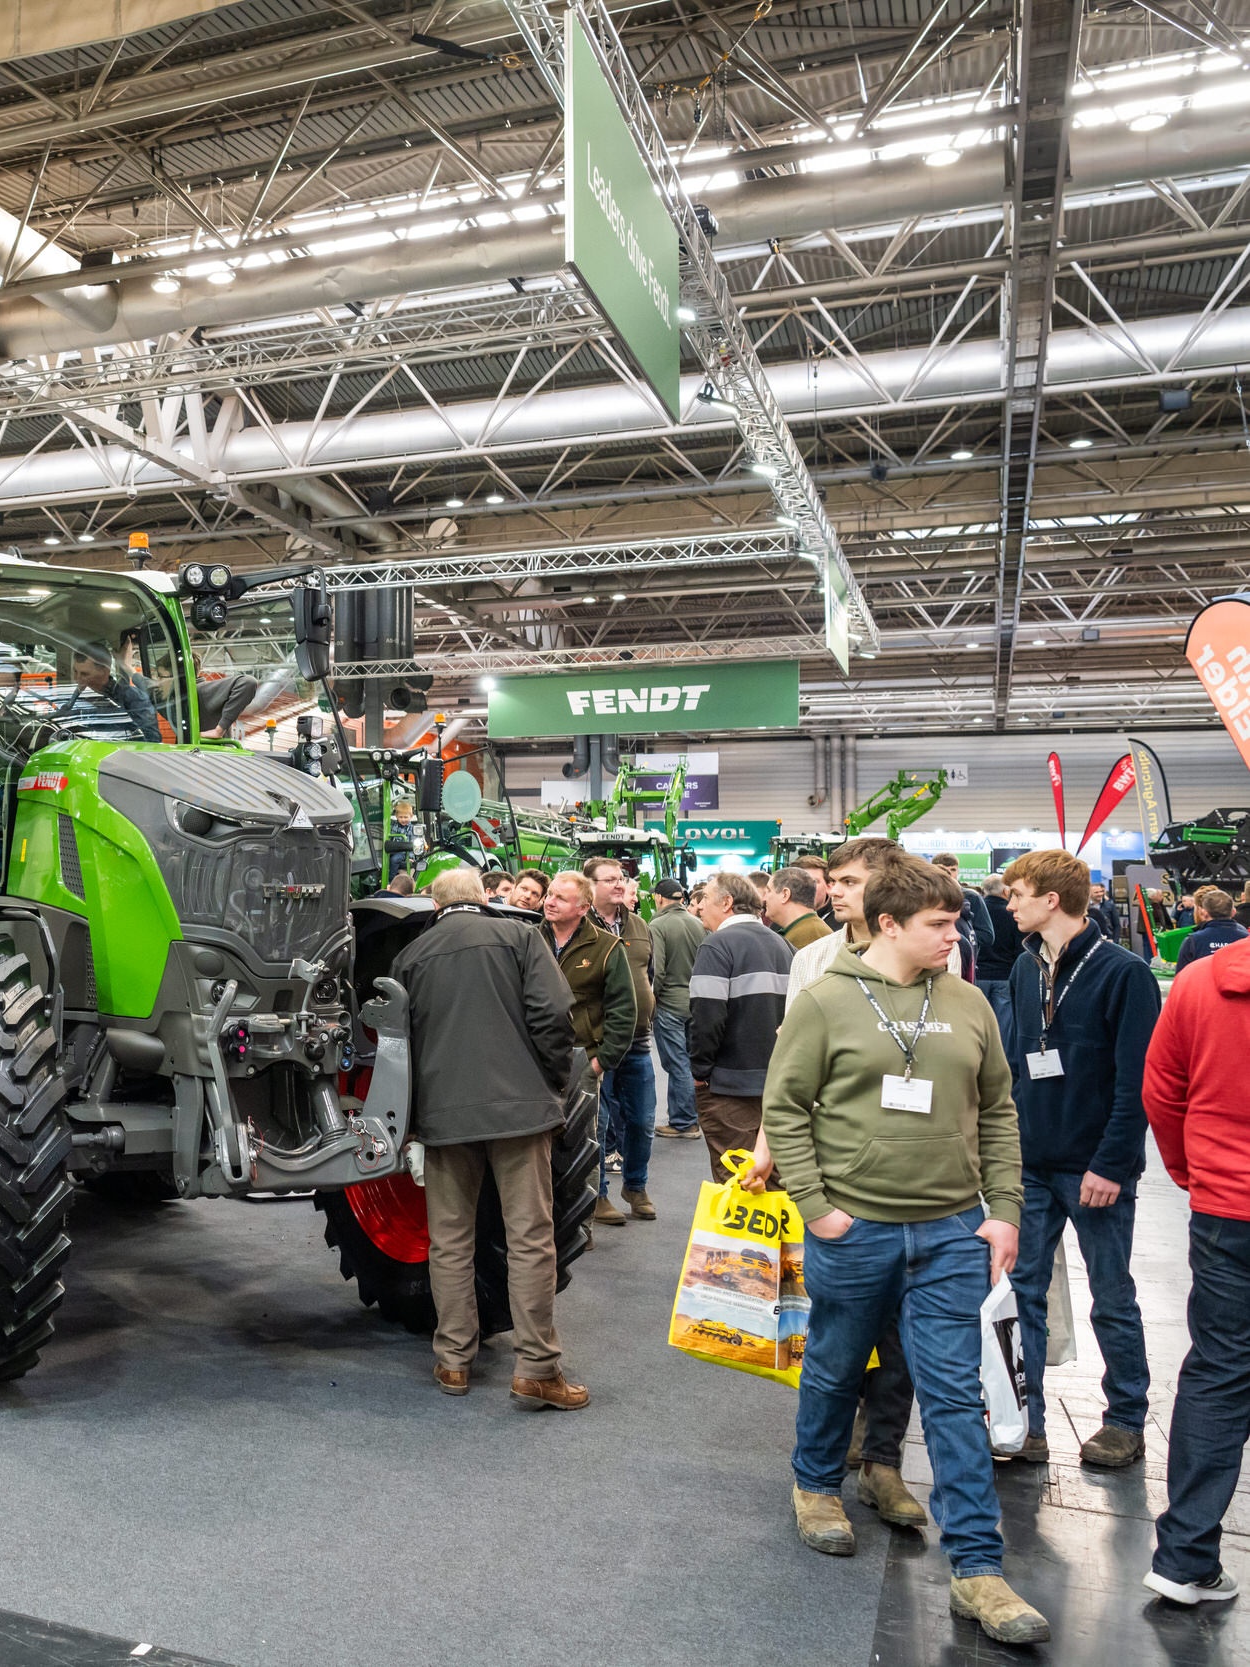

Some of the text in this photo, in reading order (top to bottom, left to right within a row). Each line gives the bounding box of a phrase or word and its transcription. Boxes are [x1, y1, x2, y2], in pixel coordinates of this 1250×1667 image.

[587, 141, 671, 330] Leaders drive Fendt.
[566, 685, 711, 716] FENDT
[36, 771, 65, 790] FENDT
[656, 781, 699, 790] CARS
[1112, 765, 1136, 792] BWT
[675, 828, 751, 840] LOVOL
[877, 1020, 952, 1033] GRASMEN
